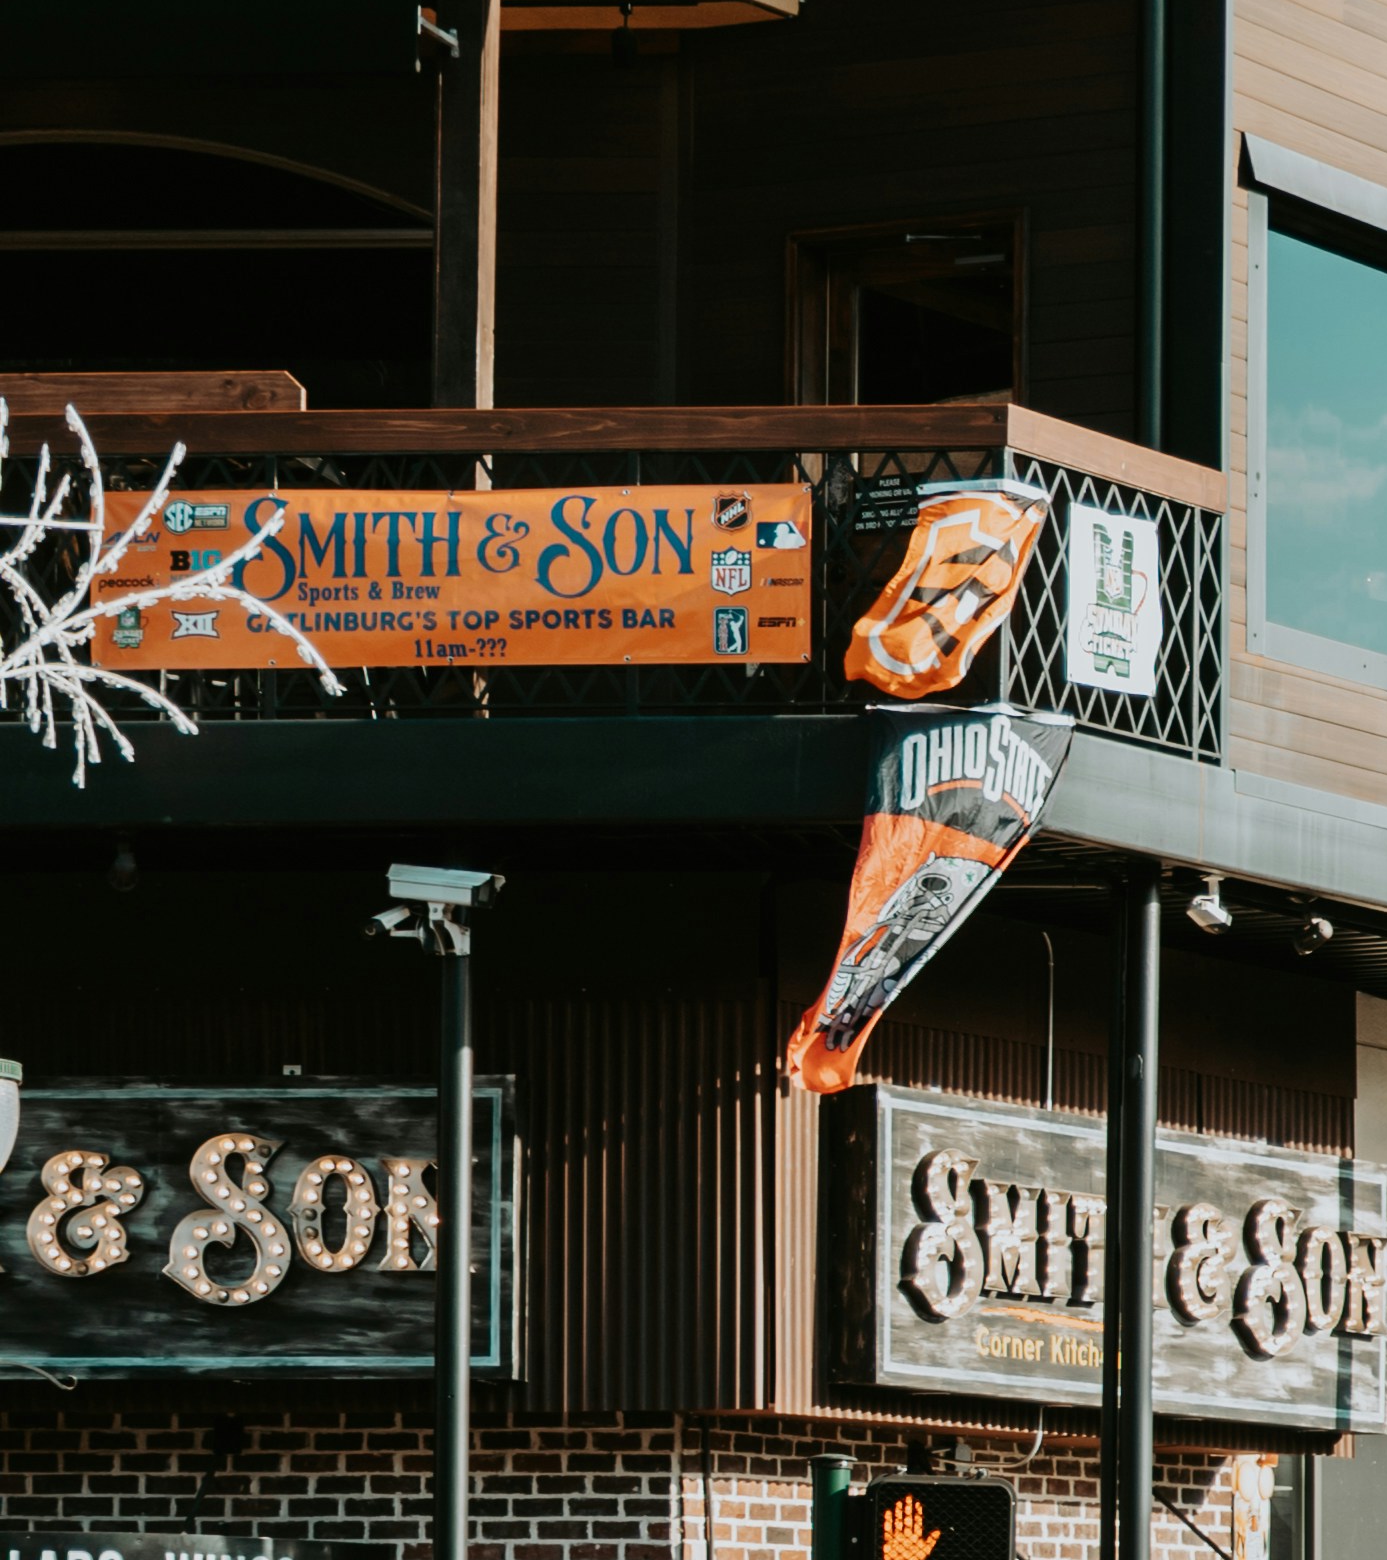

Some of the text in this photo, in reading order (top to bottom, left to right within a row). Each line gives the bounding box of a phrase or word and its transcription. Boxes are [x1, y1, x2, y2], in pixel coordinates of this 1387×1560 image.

[879, 478, 900, 487] PLEASE
[165, 501, 193, 532] SEC
[720, 502, 745, 526] NHL
[231, 495, 696, 602] SMITH & SON
[98, 574, 154, 592] peacock
[715, 568, 747, 590] NFL
[298, 580, 441, 606] Sports & Brew
[246, 607, 676, 633] GATLINBURG'S TOP SPORTS BAR
[415, 637, 507, 659] 11am-???
[900, 715, 1053, 822] OHIO STATE
[26, 1133, 438, 1306] & SON
[1166, 1202, 1237, 1328] &
[975, 1326, 1104, 1369] Corner Kitch
